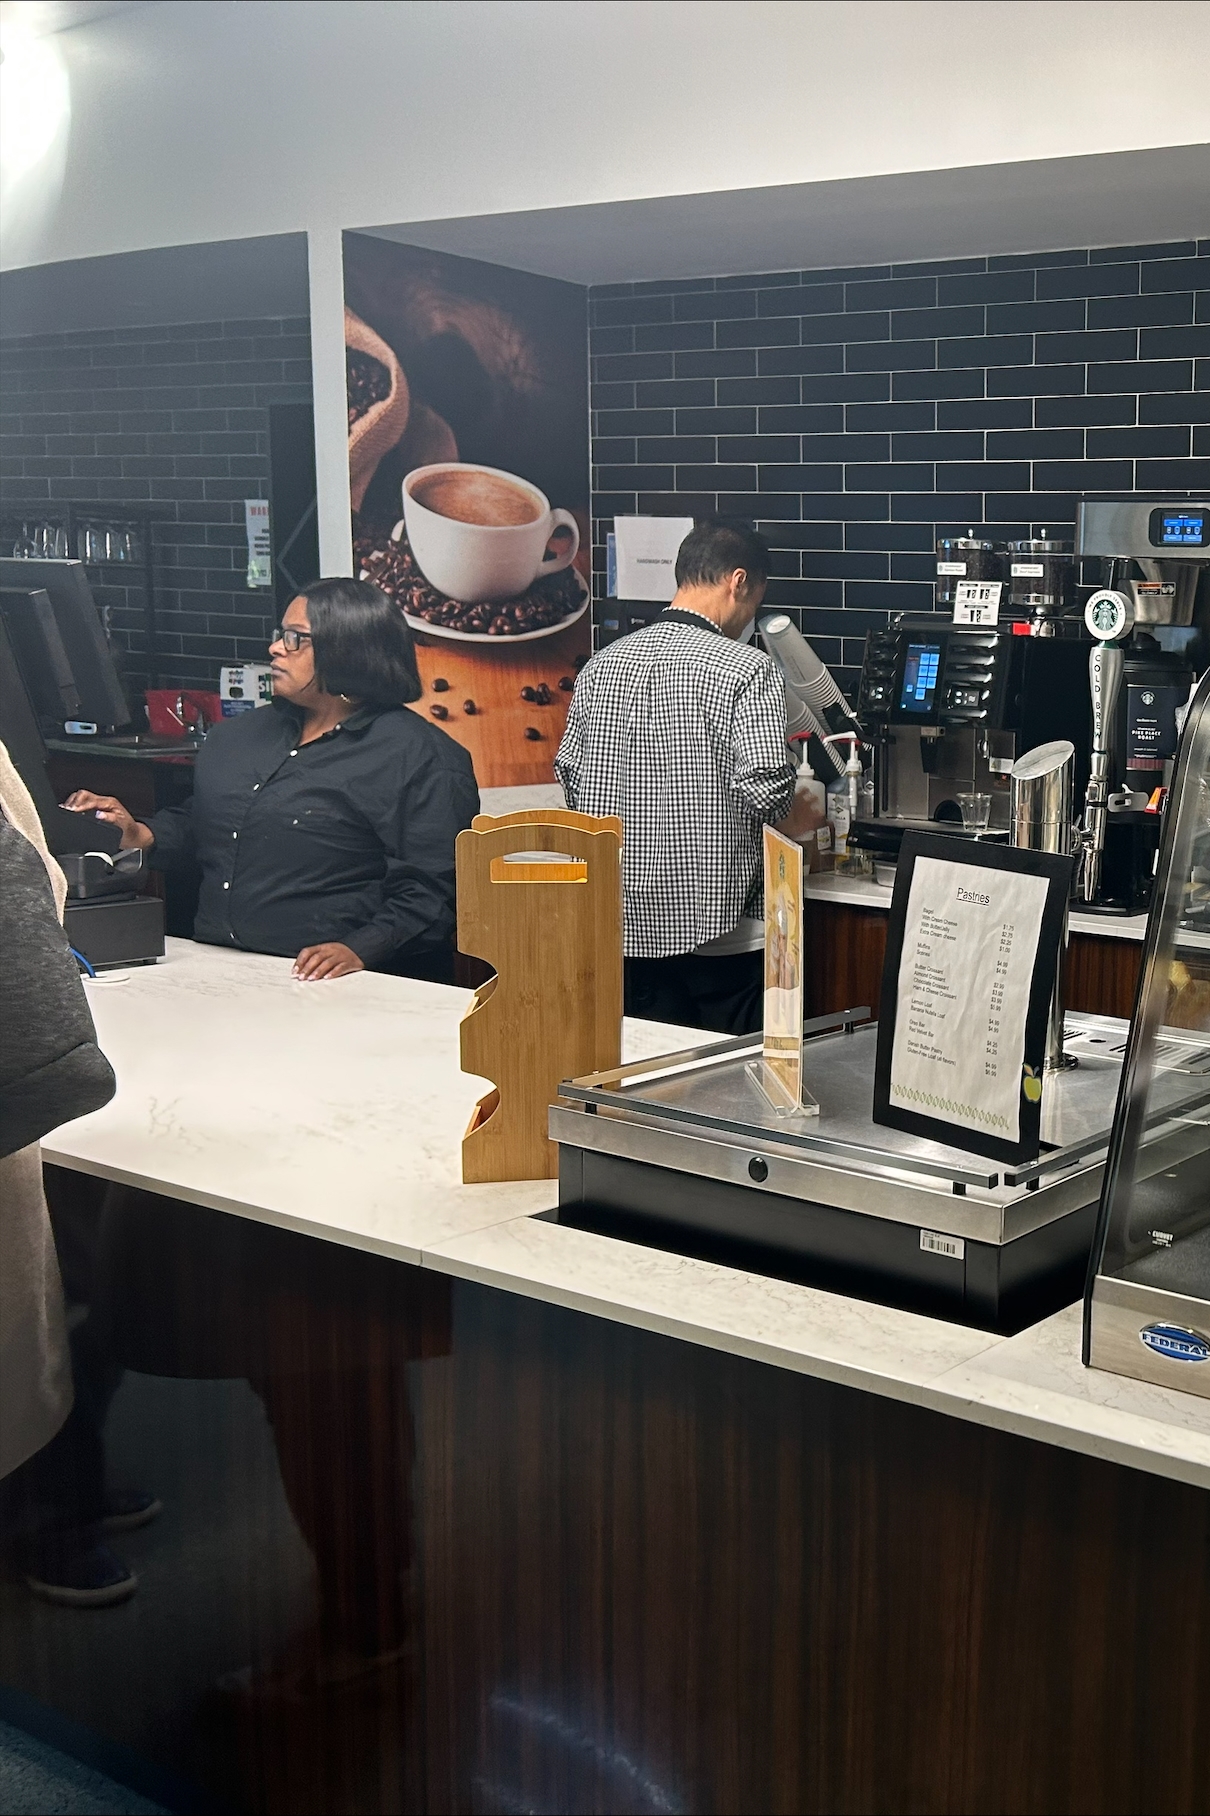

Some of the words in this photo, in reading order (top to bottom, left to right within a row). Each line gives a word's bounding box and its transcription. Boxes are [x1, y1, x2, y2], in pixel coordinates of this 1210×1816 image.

[1093, 654, 1101, 693] COLD
[1093, 702, 1101, 739] BREW
[957, 887, 990, 904] Pastries
[1142, 1331, 1210, 1358] FEDERAL
